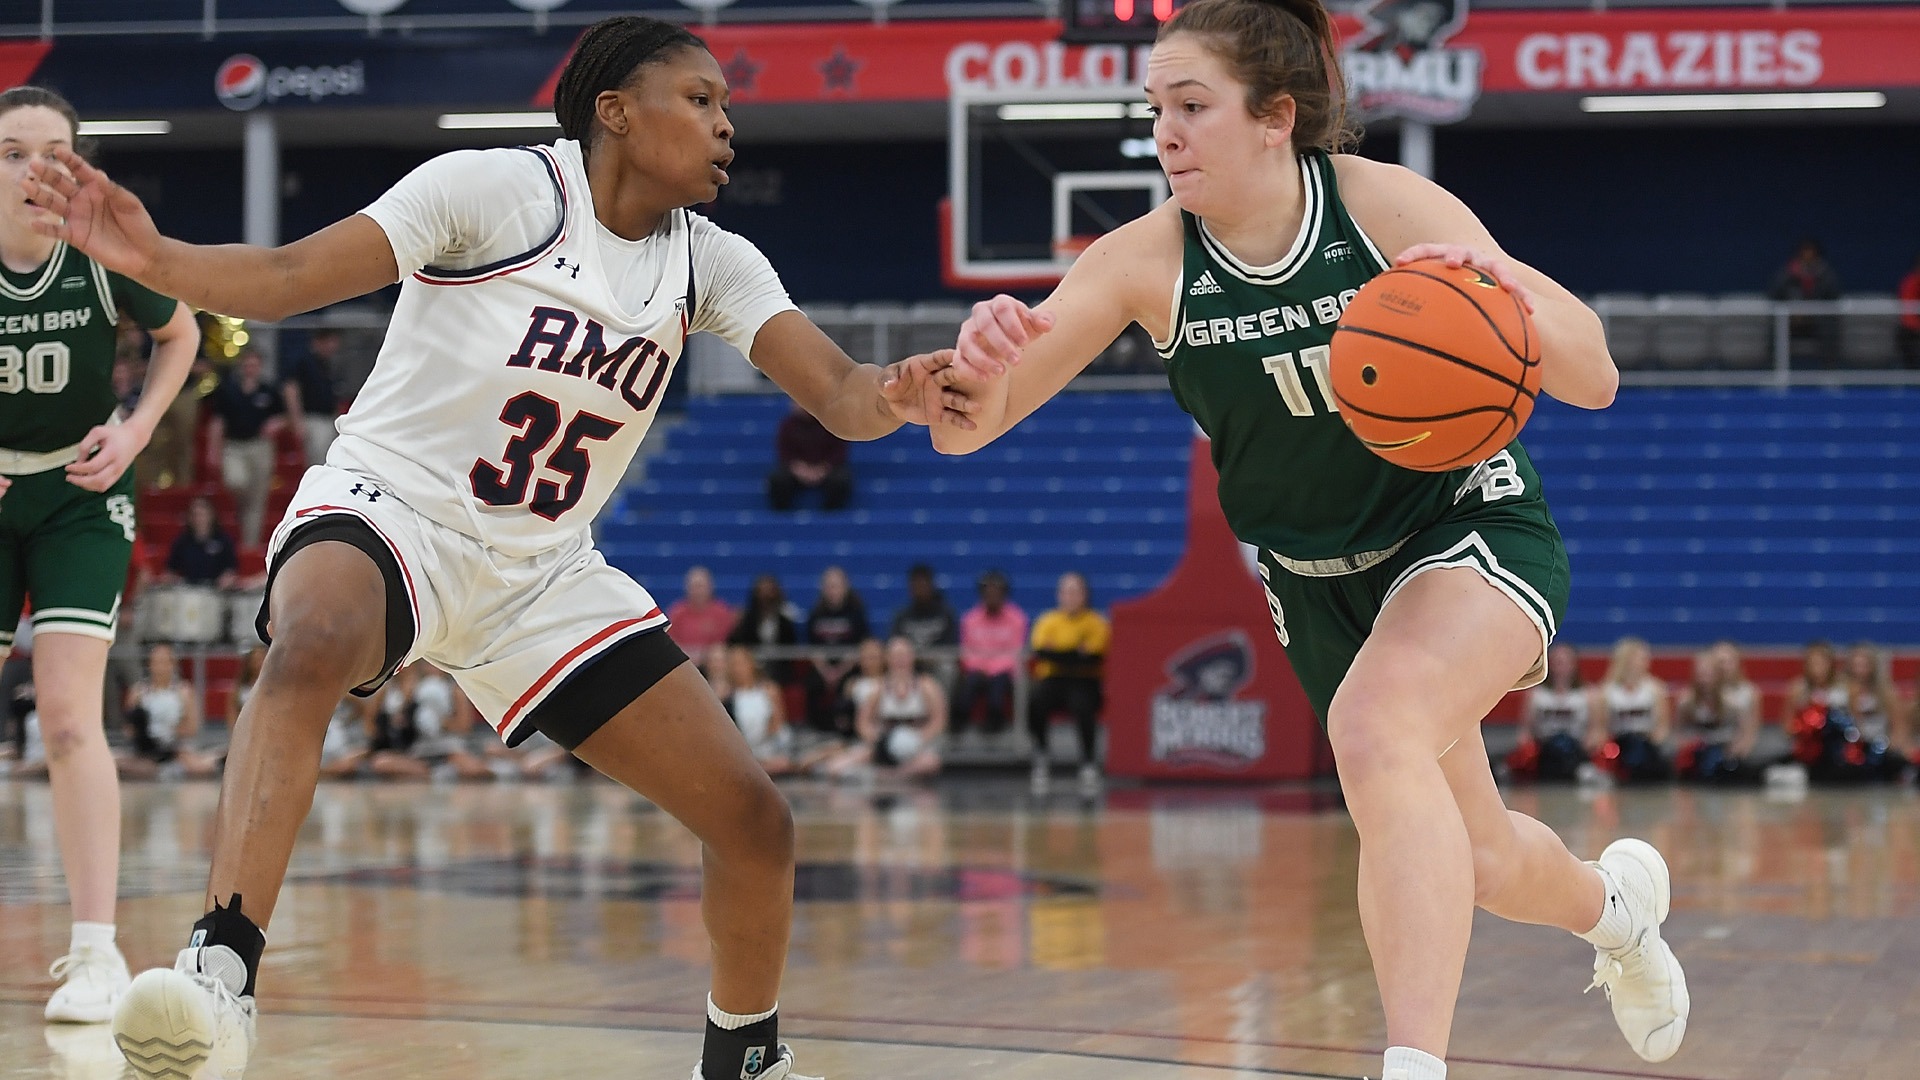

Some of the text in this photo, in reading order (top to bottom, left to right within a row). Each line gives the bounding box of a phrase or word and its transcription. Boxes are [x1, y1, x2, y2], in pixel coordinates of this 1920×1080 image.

[267, 60, 365, 101] pepsi
[944, 41, 1152, 91] COLO
[1343, 50, 1481, 103] RMU
[1514, 30, 1824, 88] CRAZIES
[1324, 246, 1352, 260] HORIZ
[1189, 285, 1225, 296] adida
[43, 307, 92, 332] BAY
[1185, 304, 1310, 347] GREEN
[506, 305, 670, 412] RMU
[1261, 344, 1340, 417] 11
[468, 390, 626, 522] 35
